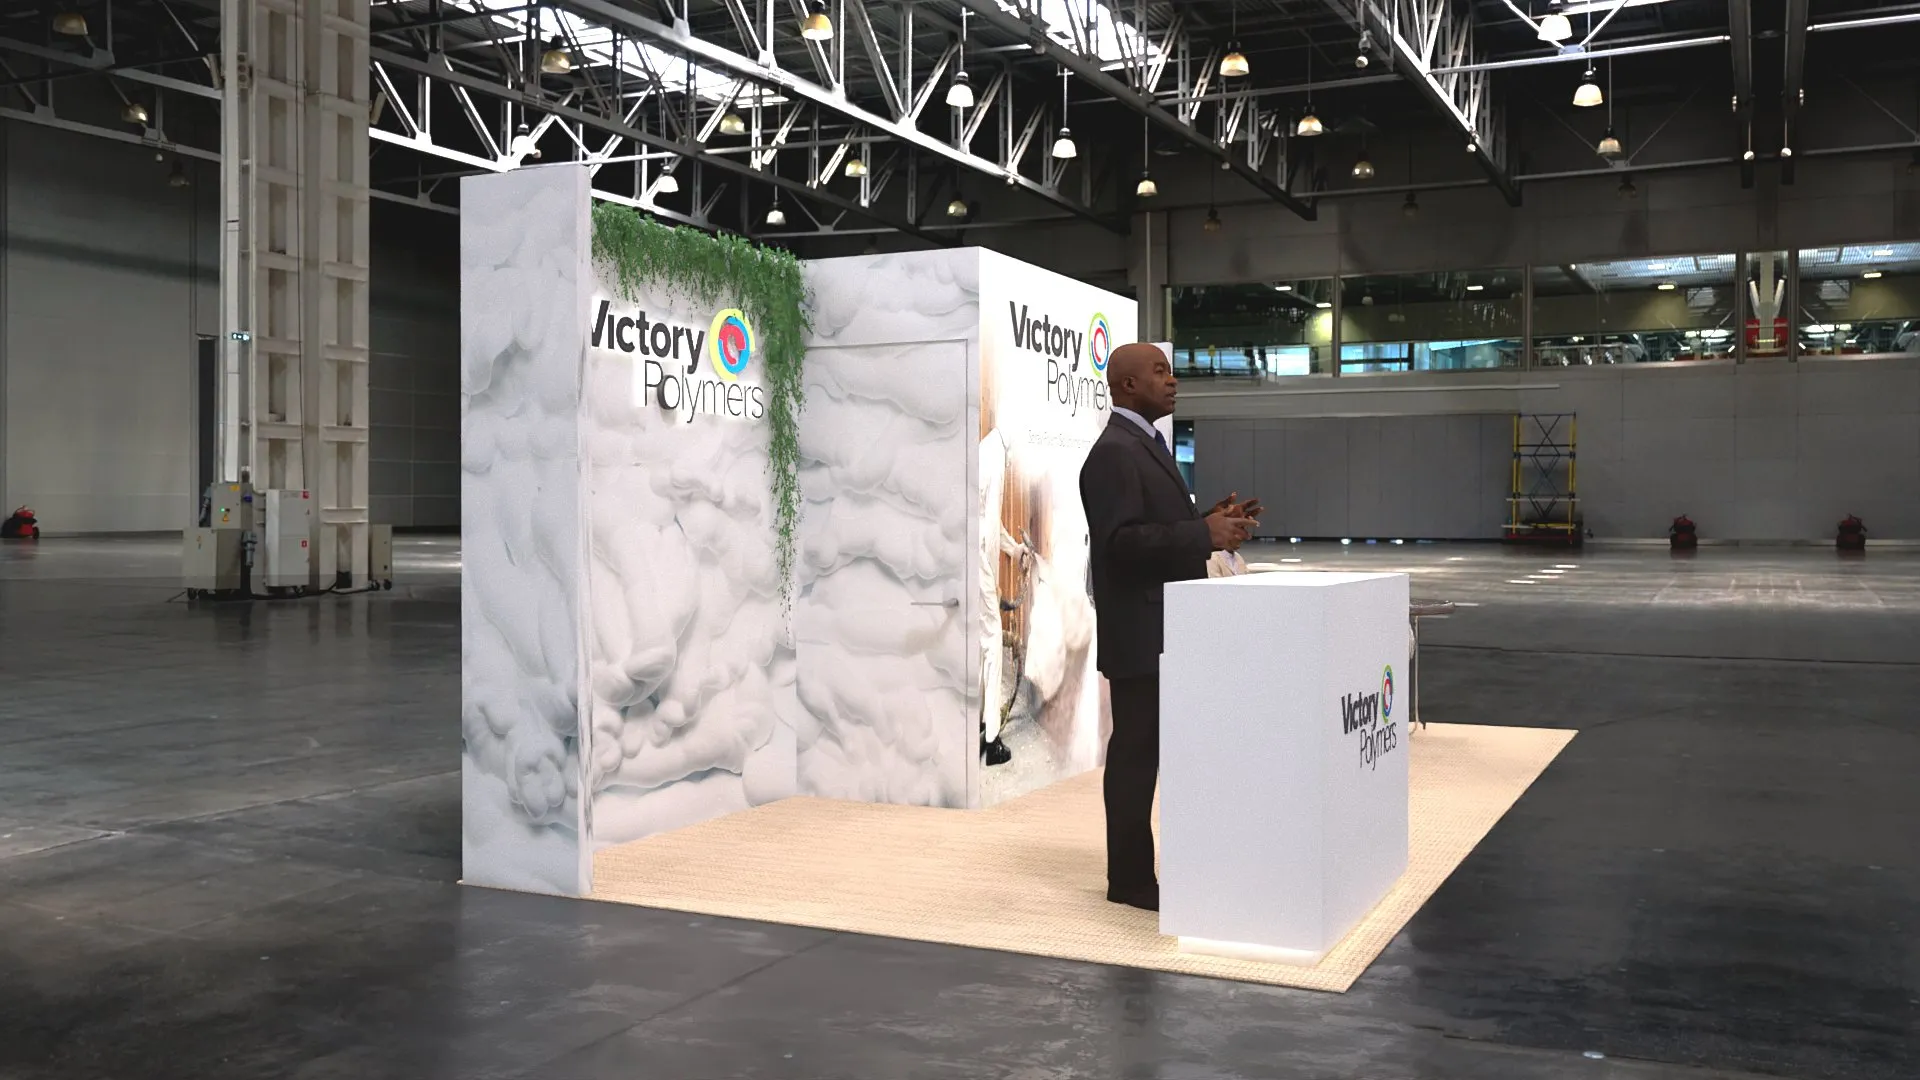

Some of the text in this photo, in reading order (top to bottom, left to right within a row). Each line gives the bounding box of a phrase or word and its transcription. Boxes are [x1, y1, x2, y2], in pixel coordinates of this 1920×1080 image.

[591, 299, 705, 375] Victory
[1009, 300, 1083, 373] Victory
[644, 359, 764, 424] Polymers
[1047, 358, 1113, 418] Polymer
[1341, 691, 1379, 735] Victory
[1360, 721, 1397, 771] Polymers
